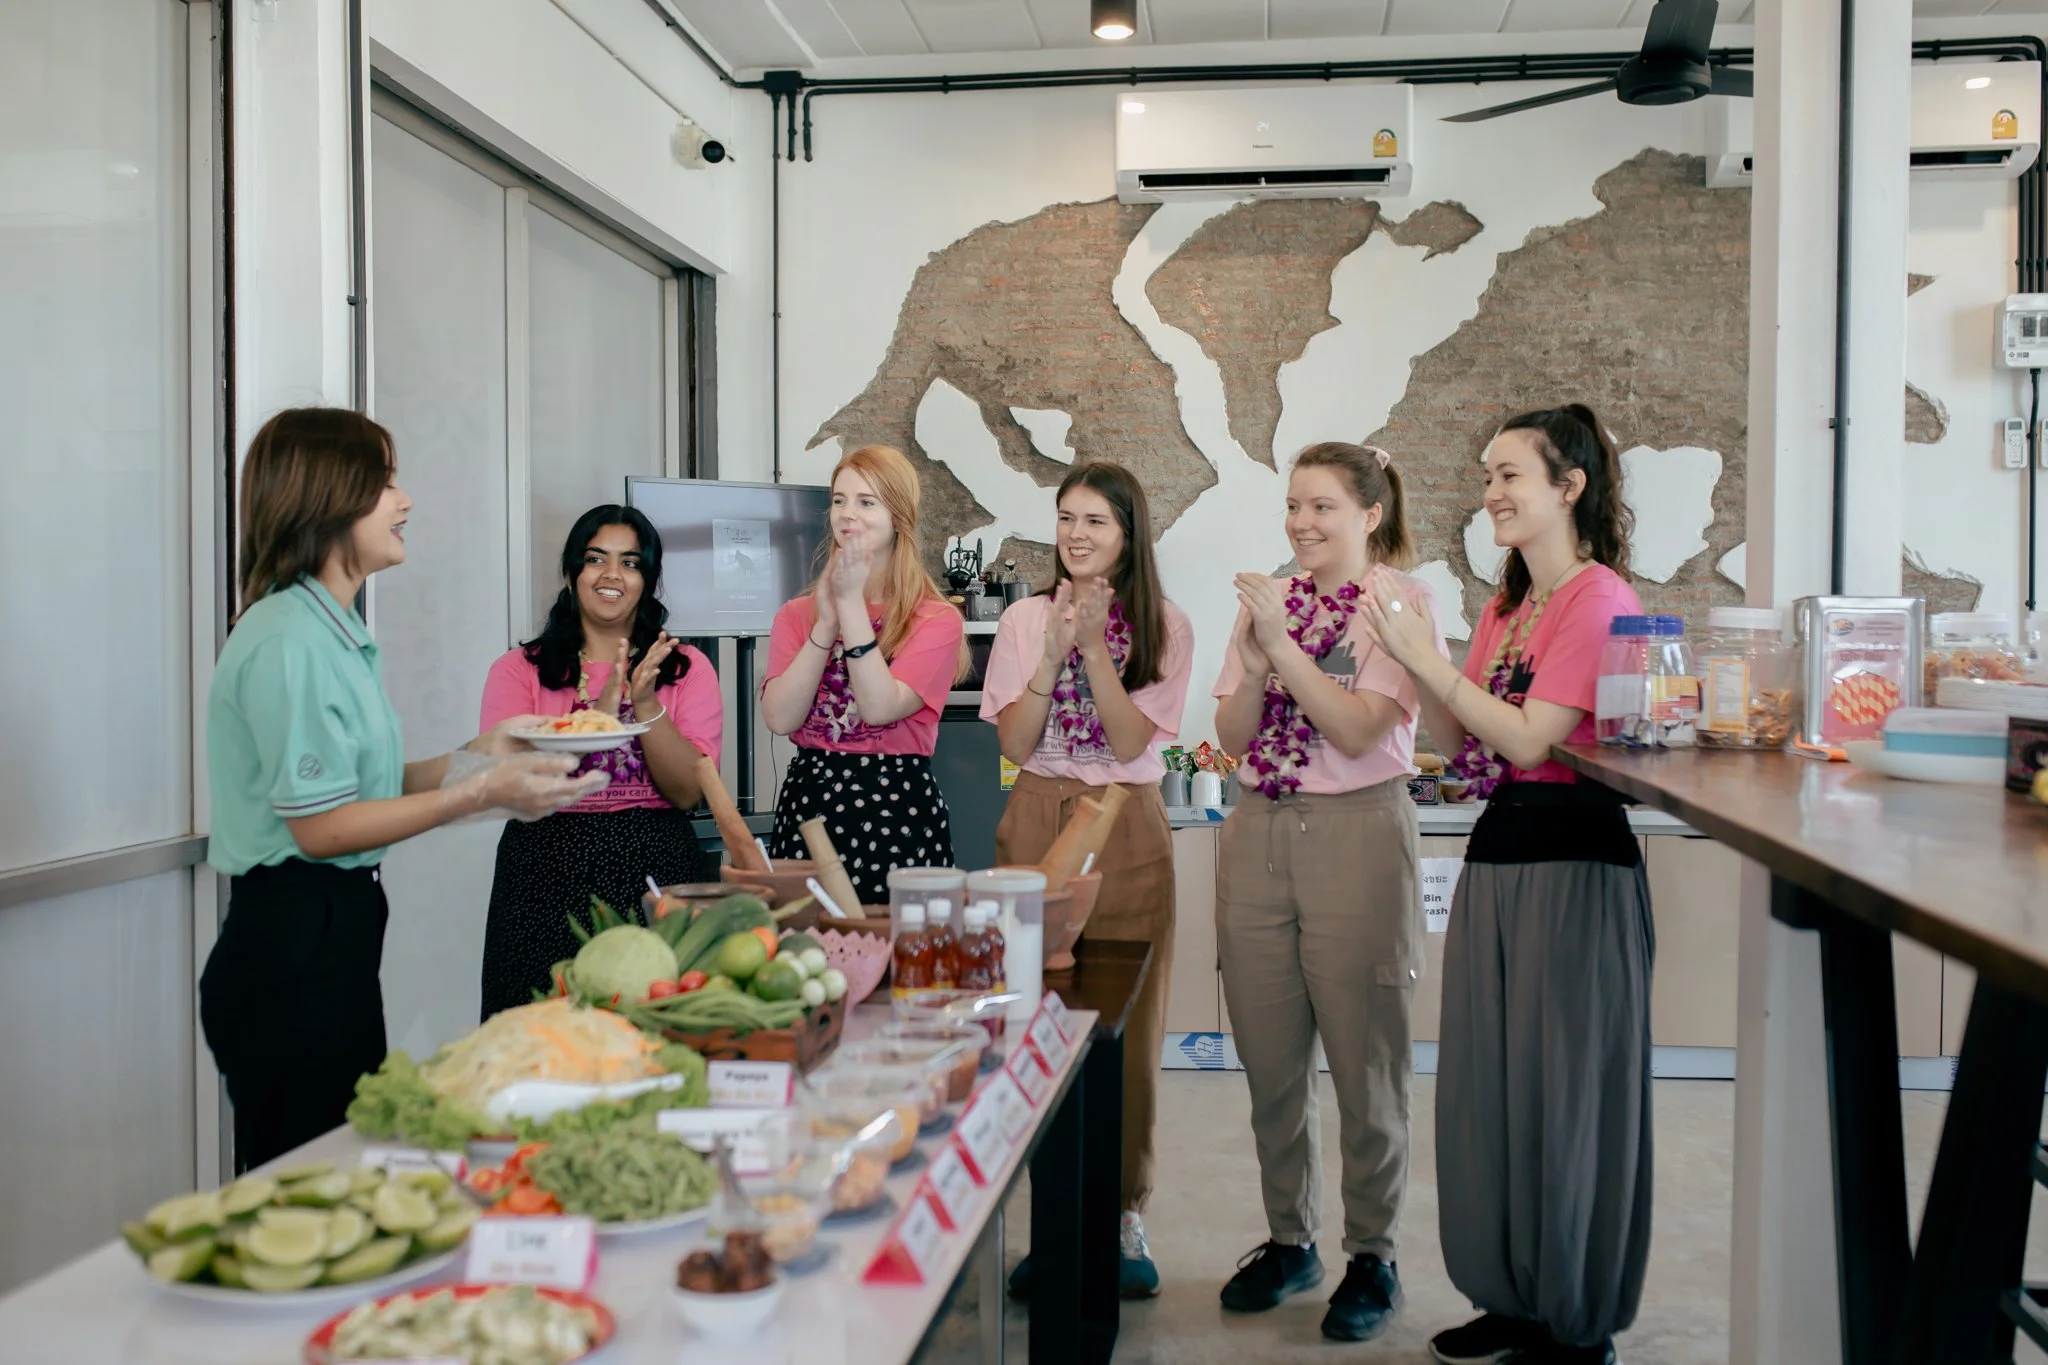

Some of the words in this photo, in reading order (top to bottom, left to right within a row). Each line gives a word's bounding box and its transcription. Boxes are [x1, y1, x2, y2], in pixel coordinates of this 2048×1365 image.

[606, 789, 626, 800] you
[630, 789, 648, 797] can
[1424, 894, 1442, 902] Bin
[1425, 907, 1448, 915] rash
